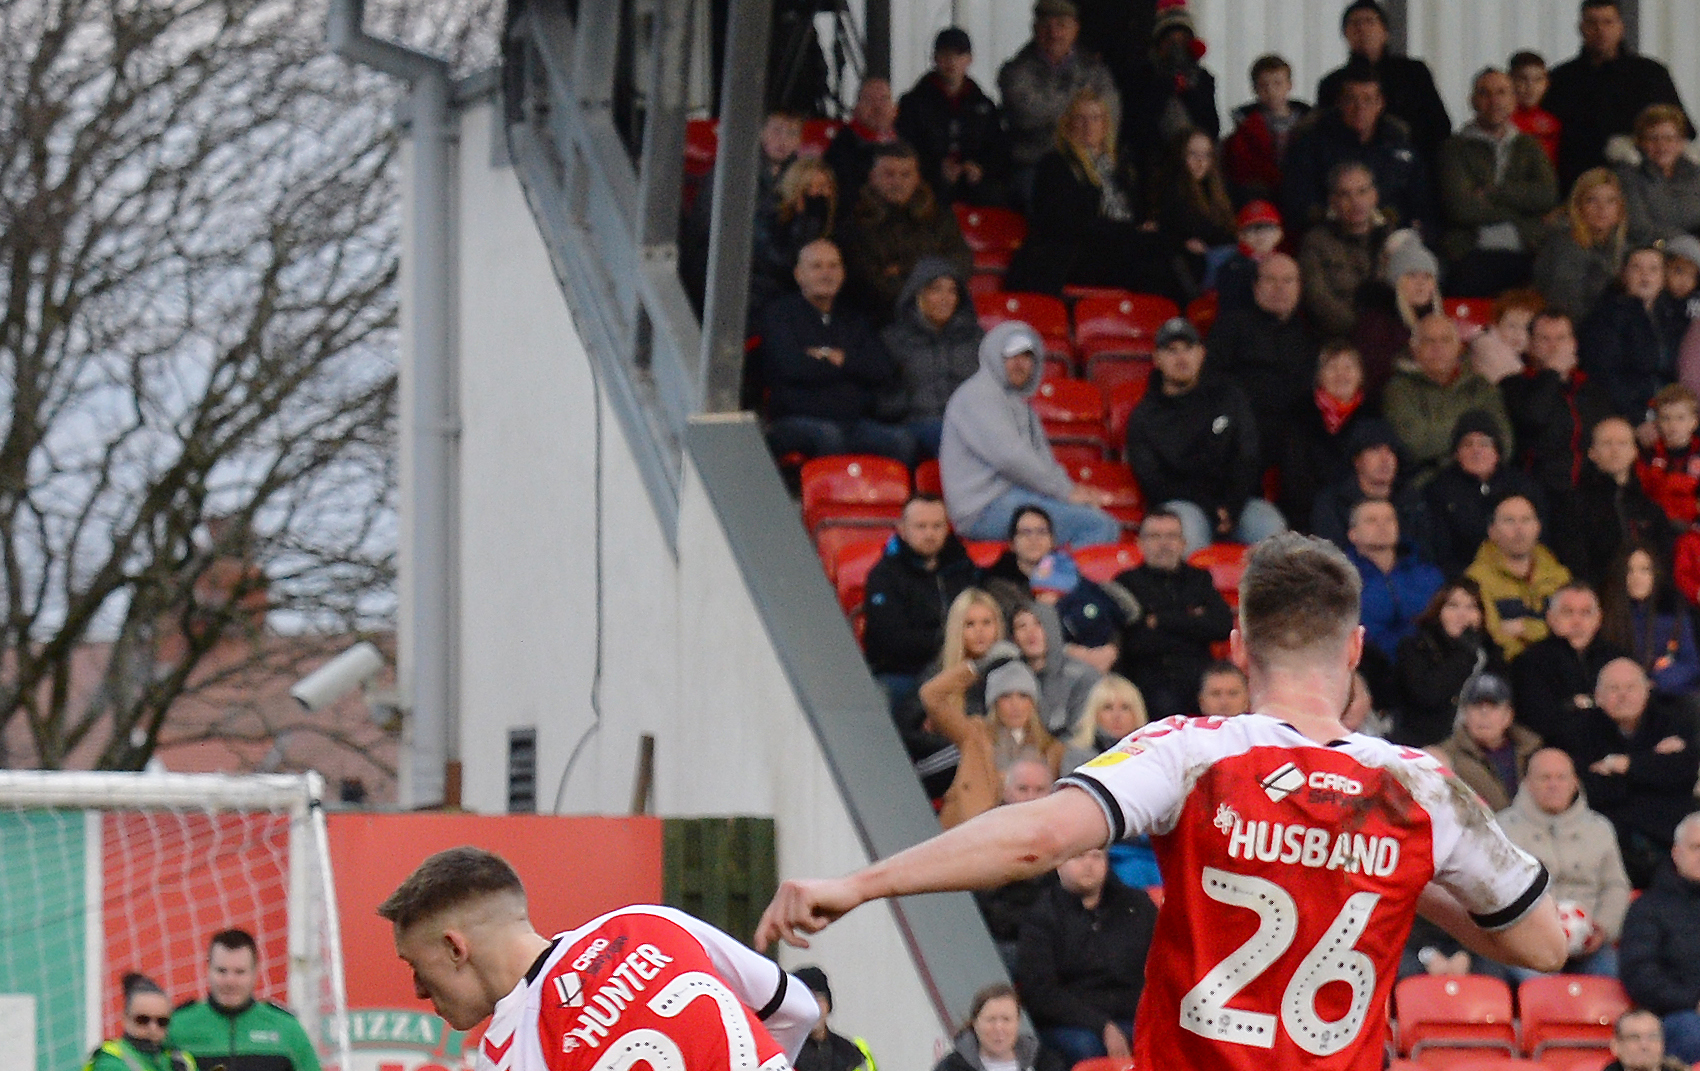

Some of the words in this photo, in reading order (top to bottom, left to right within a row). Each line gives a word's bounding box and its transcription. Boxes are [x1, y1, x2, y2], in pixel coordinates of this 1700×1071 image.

[1308, 771, 1363, 795] CARD
[1228, 820, 1400, 877] HUSBAND
[577, 943, 674, 1048] HUNTER
[1179, 866, 1381, 1056] 26
